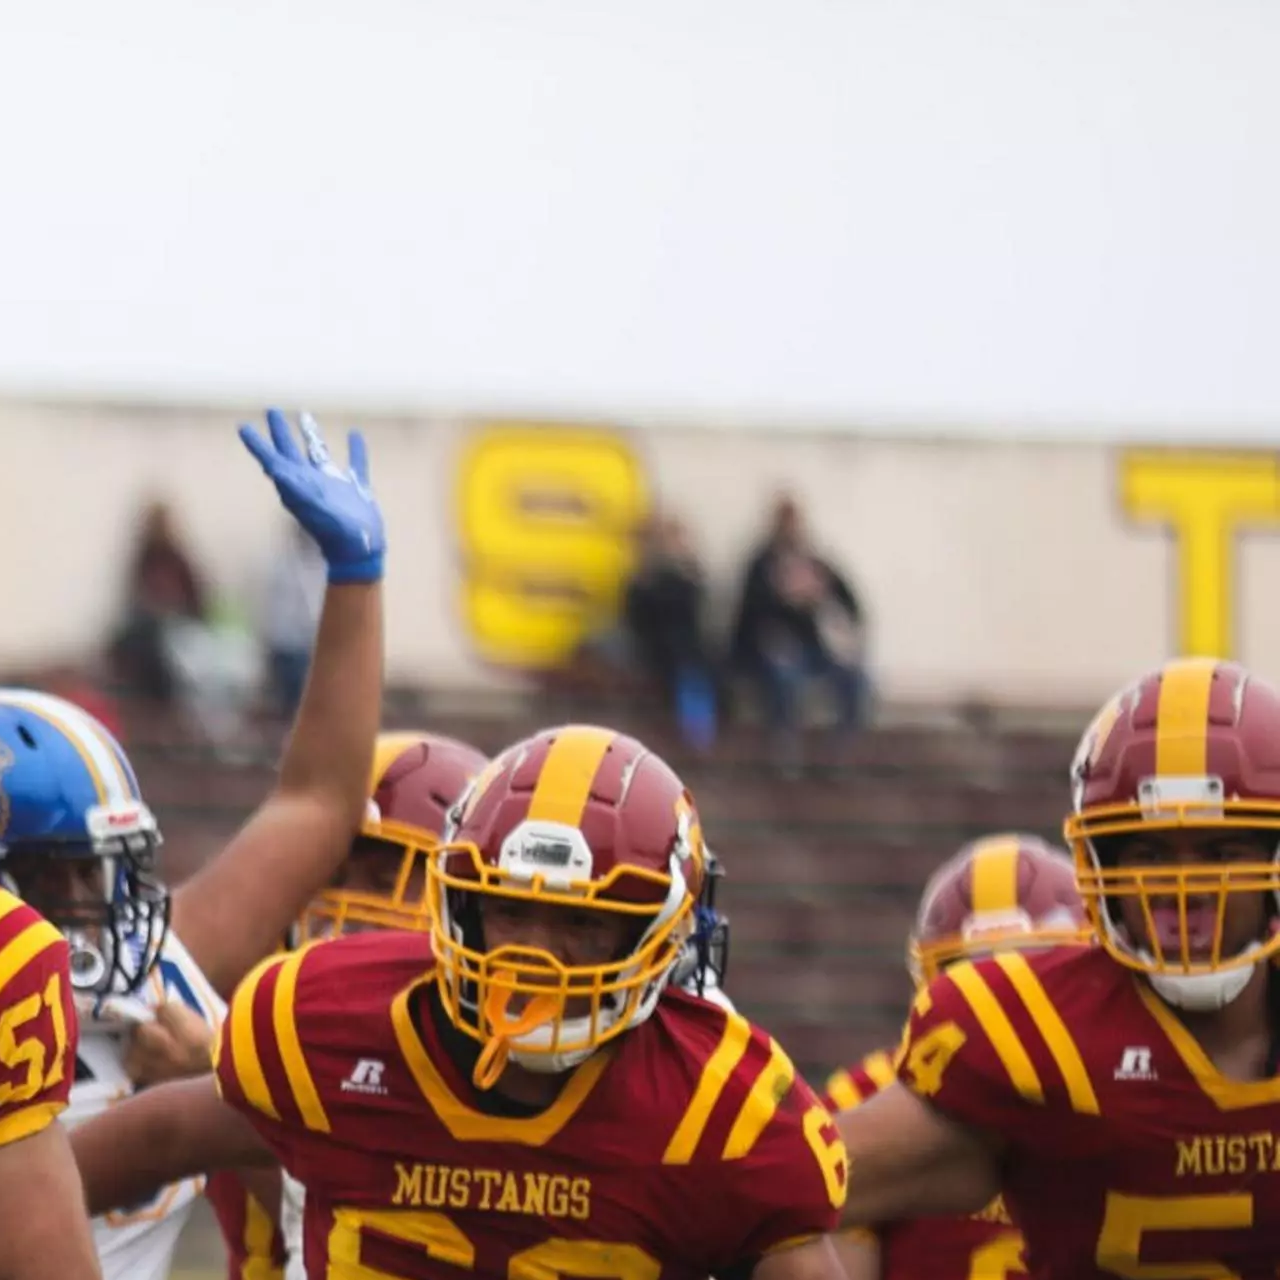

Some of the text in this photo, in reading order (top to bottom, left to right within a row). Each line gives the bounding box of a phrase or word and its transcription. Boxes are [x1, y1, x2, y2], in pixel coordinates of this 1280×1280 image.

[457, 424, 648, 668] S
[1120, 448, 1280, 660] T
[391, 1162, 591, 1219] MUSTANGS
